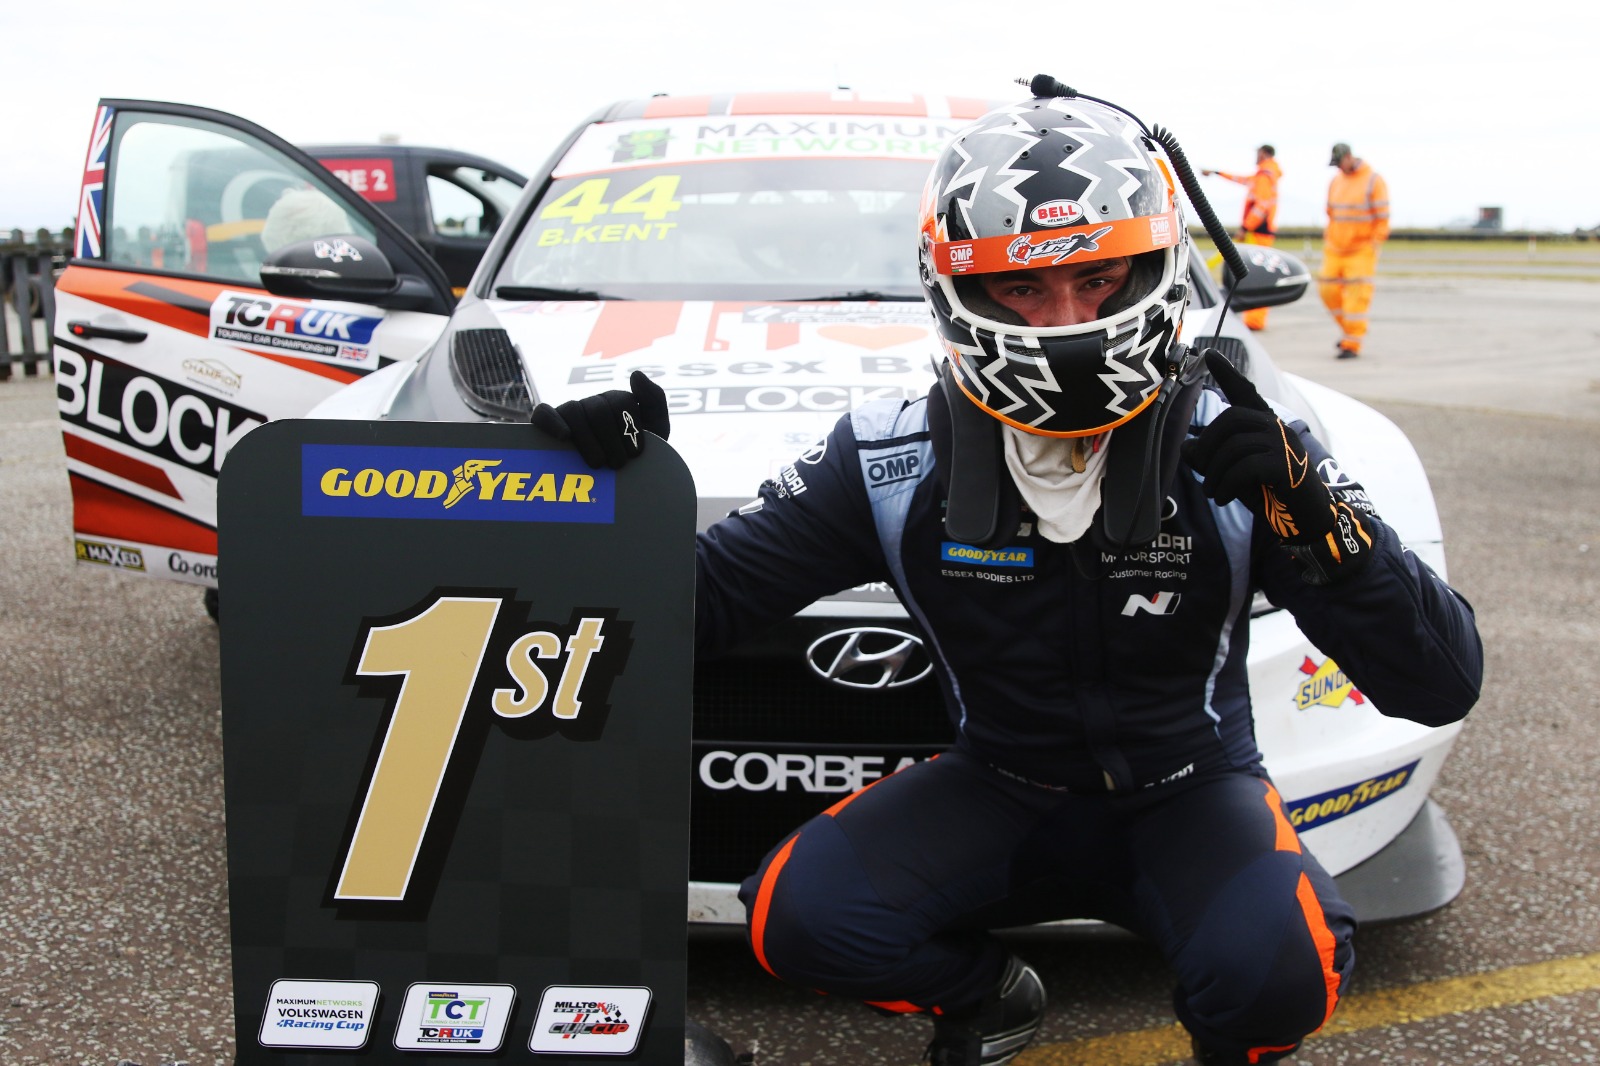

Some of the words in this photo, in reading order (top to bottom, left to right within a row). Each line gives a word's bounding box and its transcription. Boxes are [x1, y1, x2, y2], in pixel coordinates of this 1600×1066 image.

[371, 169, 389, 191] 2
[540, 174, 682, 224] 44
[1038, 205, 1077, 220] BELL
[537, 223, 678, 247] B.KENT
[950, 247, 974, 262] OMP
[218, 328, 253, 342] TOURING
[252, 333, 272, 345] CAR
[272, 336, 337, 355] CHAMPIONSHIP
[181, 359, 241, 389] CHAMPION
[567, 359, 826, 385] Essex
[54, 343, 263, 473] BLOCK
[868, 457, 921, 482] OMP
[87, 544, 142, 567] MAXED
[1101, 551, 1193, 565] MORSPORT
[941, 569, 975, 579] ESSEX
[976, 571, 1014, 583] BODIES
[1014, 573, 1035, 583] LTD
[1154, 570, 1187, 581] Racing
[1301, 669, 1351, 705] SUNO
[333, 596, 605, 901] 1st
[699, 750, 932, 794] CORBE
[278, 1008, 363, 1019] VOLKSWAGEN
[316, 999, 363, 1007] NETWORKS
[428, 999, 486, 1020] TCT
[282, 1019, 334, 1031] Racing
[336, 1020, 365, 1031] Cup
